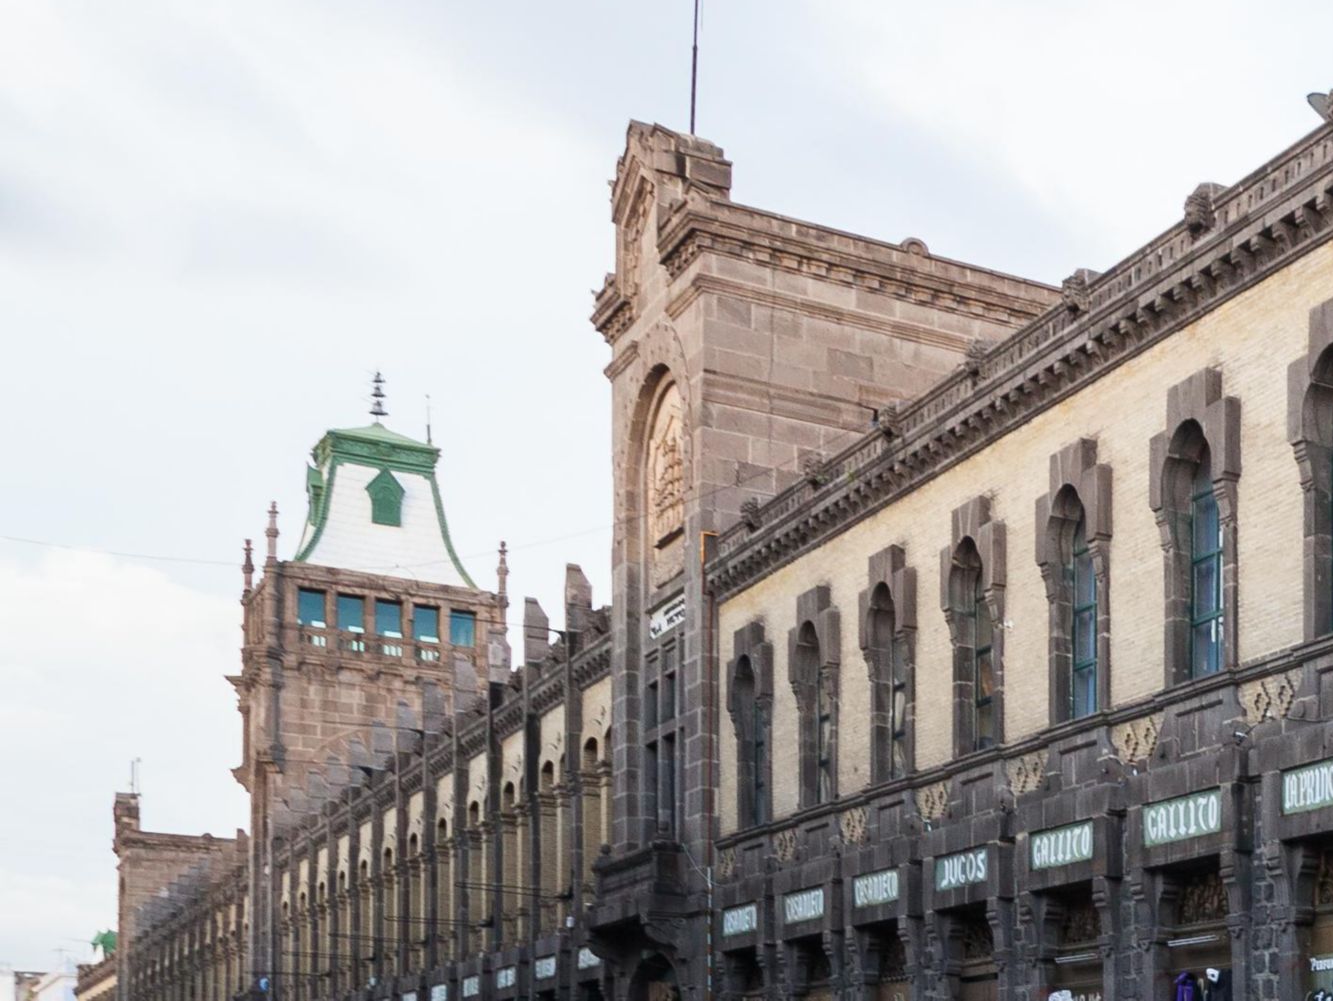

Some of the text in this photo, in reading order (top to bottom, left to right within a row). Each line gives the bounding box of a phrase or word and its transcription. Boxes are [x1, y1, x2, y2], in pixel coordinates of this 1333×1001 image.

[1148, 795, 1217, 839] GALLITO
[1033, 825, 1090, 866] GALLITO
[941, 851, 986, 887] JUGOS
